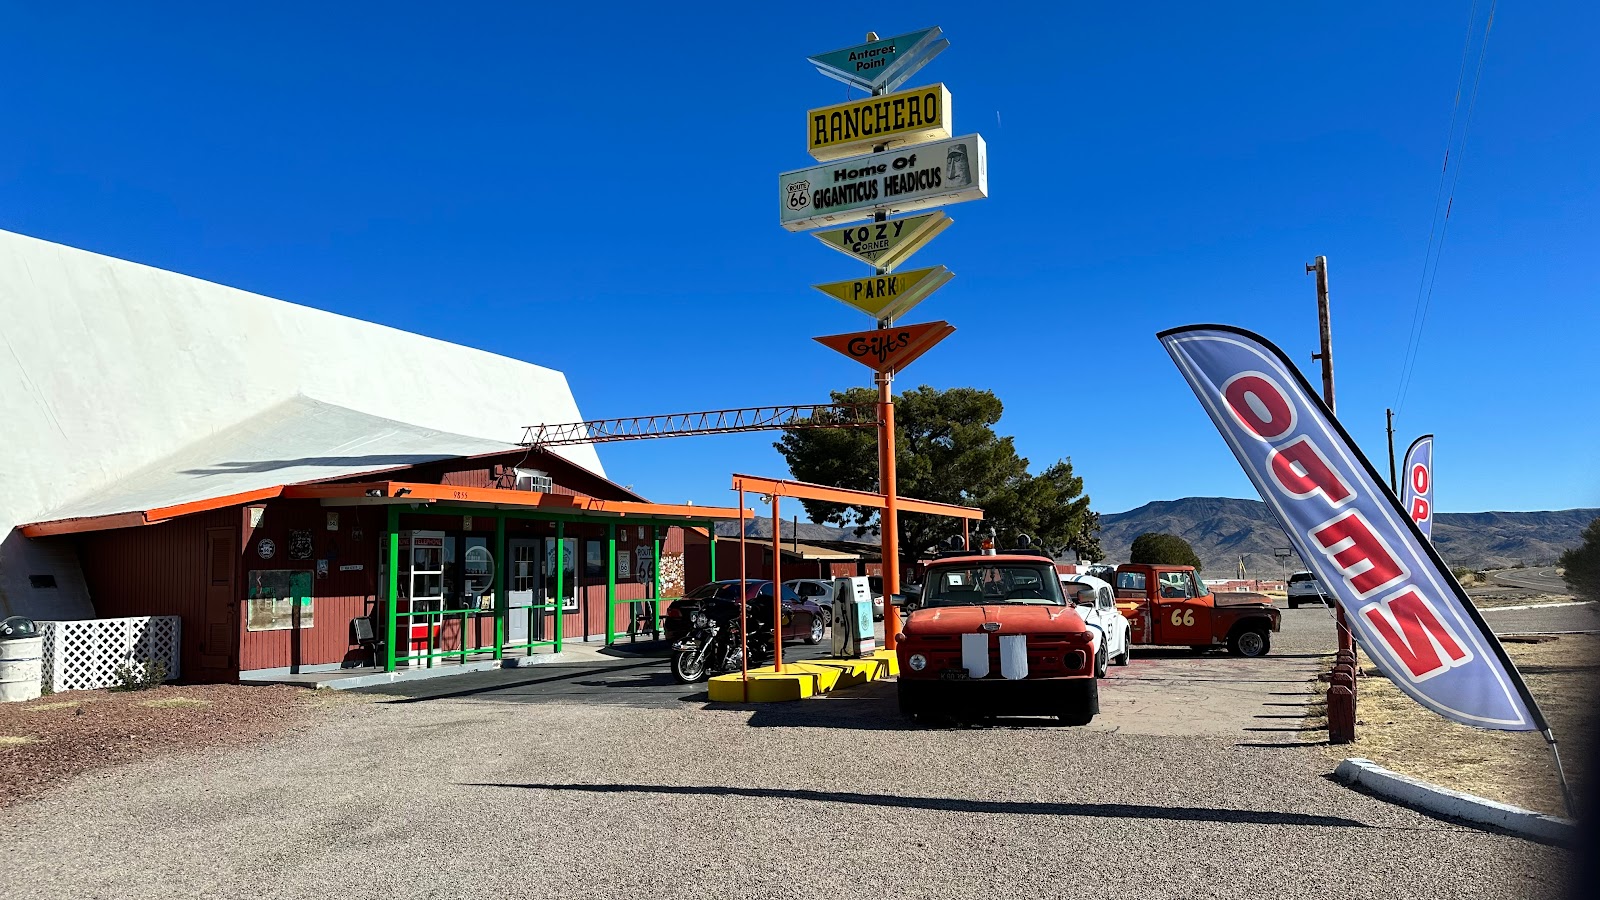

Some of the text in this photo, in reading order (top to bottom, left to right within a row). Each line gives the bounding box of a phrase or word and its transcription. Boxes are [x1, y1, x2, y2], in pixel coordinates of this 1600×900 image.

[848, 45, 896, 62] Antares
[856, 57, 885, 71] Point
[814, 92, 937, 145] RANCHERO
[834, 153, 917, 182] Home Of
[789, 181, 808, 192] ROUTE
[813, 166, 941, 209] GIGANTICUS HEADICUS
[790, 191, 807, 208] 66
[843, 220, 904, 245] KOZY
[852, 239, 889, 253] CORNER
[854, 276, 896, 300] PARK
[848, 332, 910, 363] Gifts
[453, 490, 468, 499] 9855
[1411, 464, 1429, 525] OP
[1171, 608, 1194, 626] 66
